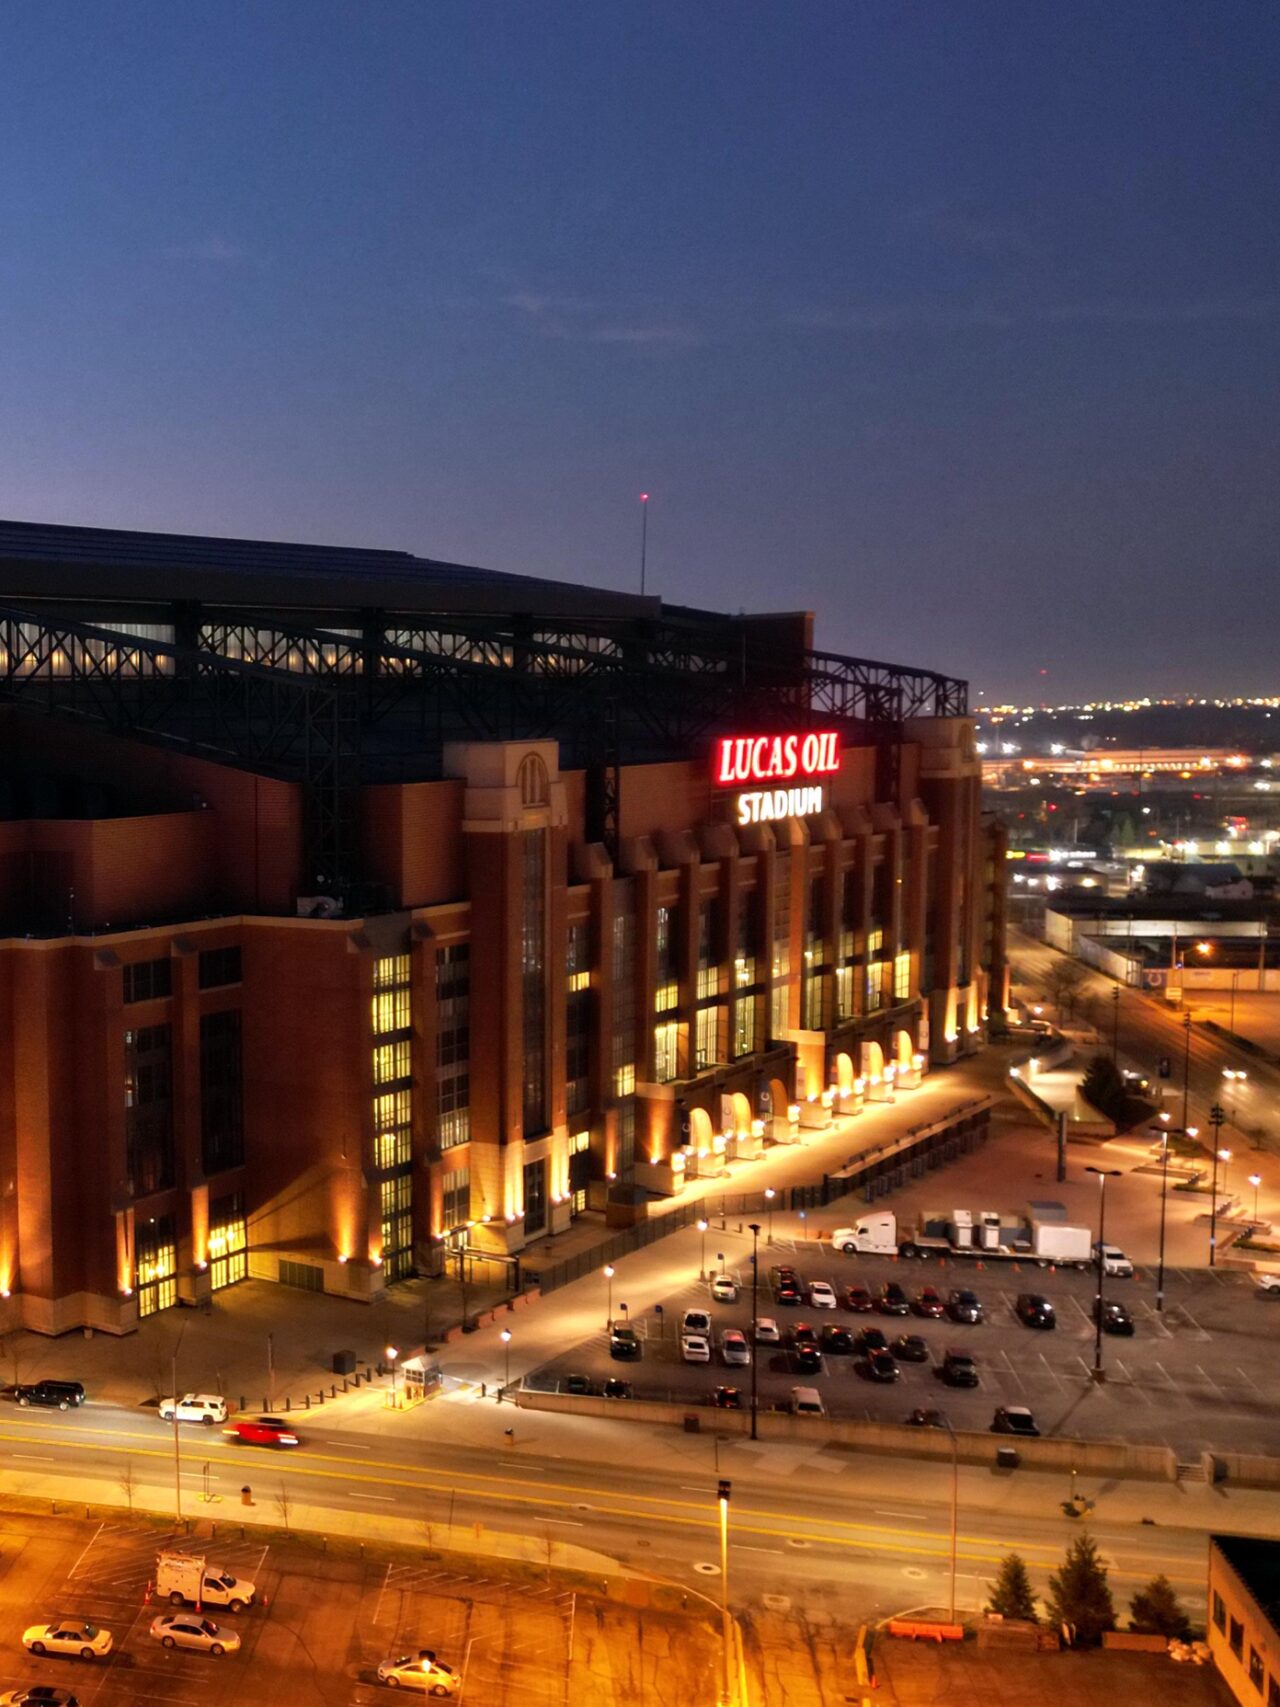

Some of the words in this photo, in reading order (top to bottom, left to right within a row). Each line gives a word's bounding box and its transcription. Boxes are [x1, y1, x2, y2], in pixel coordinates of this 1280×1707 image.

[720, 735, 798, 782] LUCAS
[802, 732, 840, 773] OIL
[738, 786, 822, 826] STADIUM
